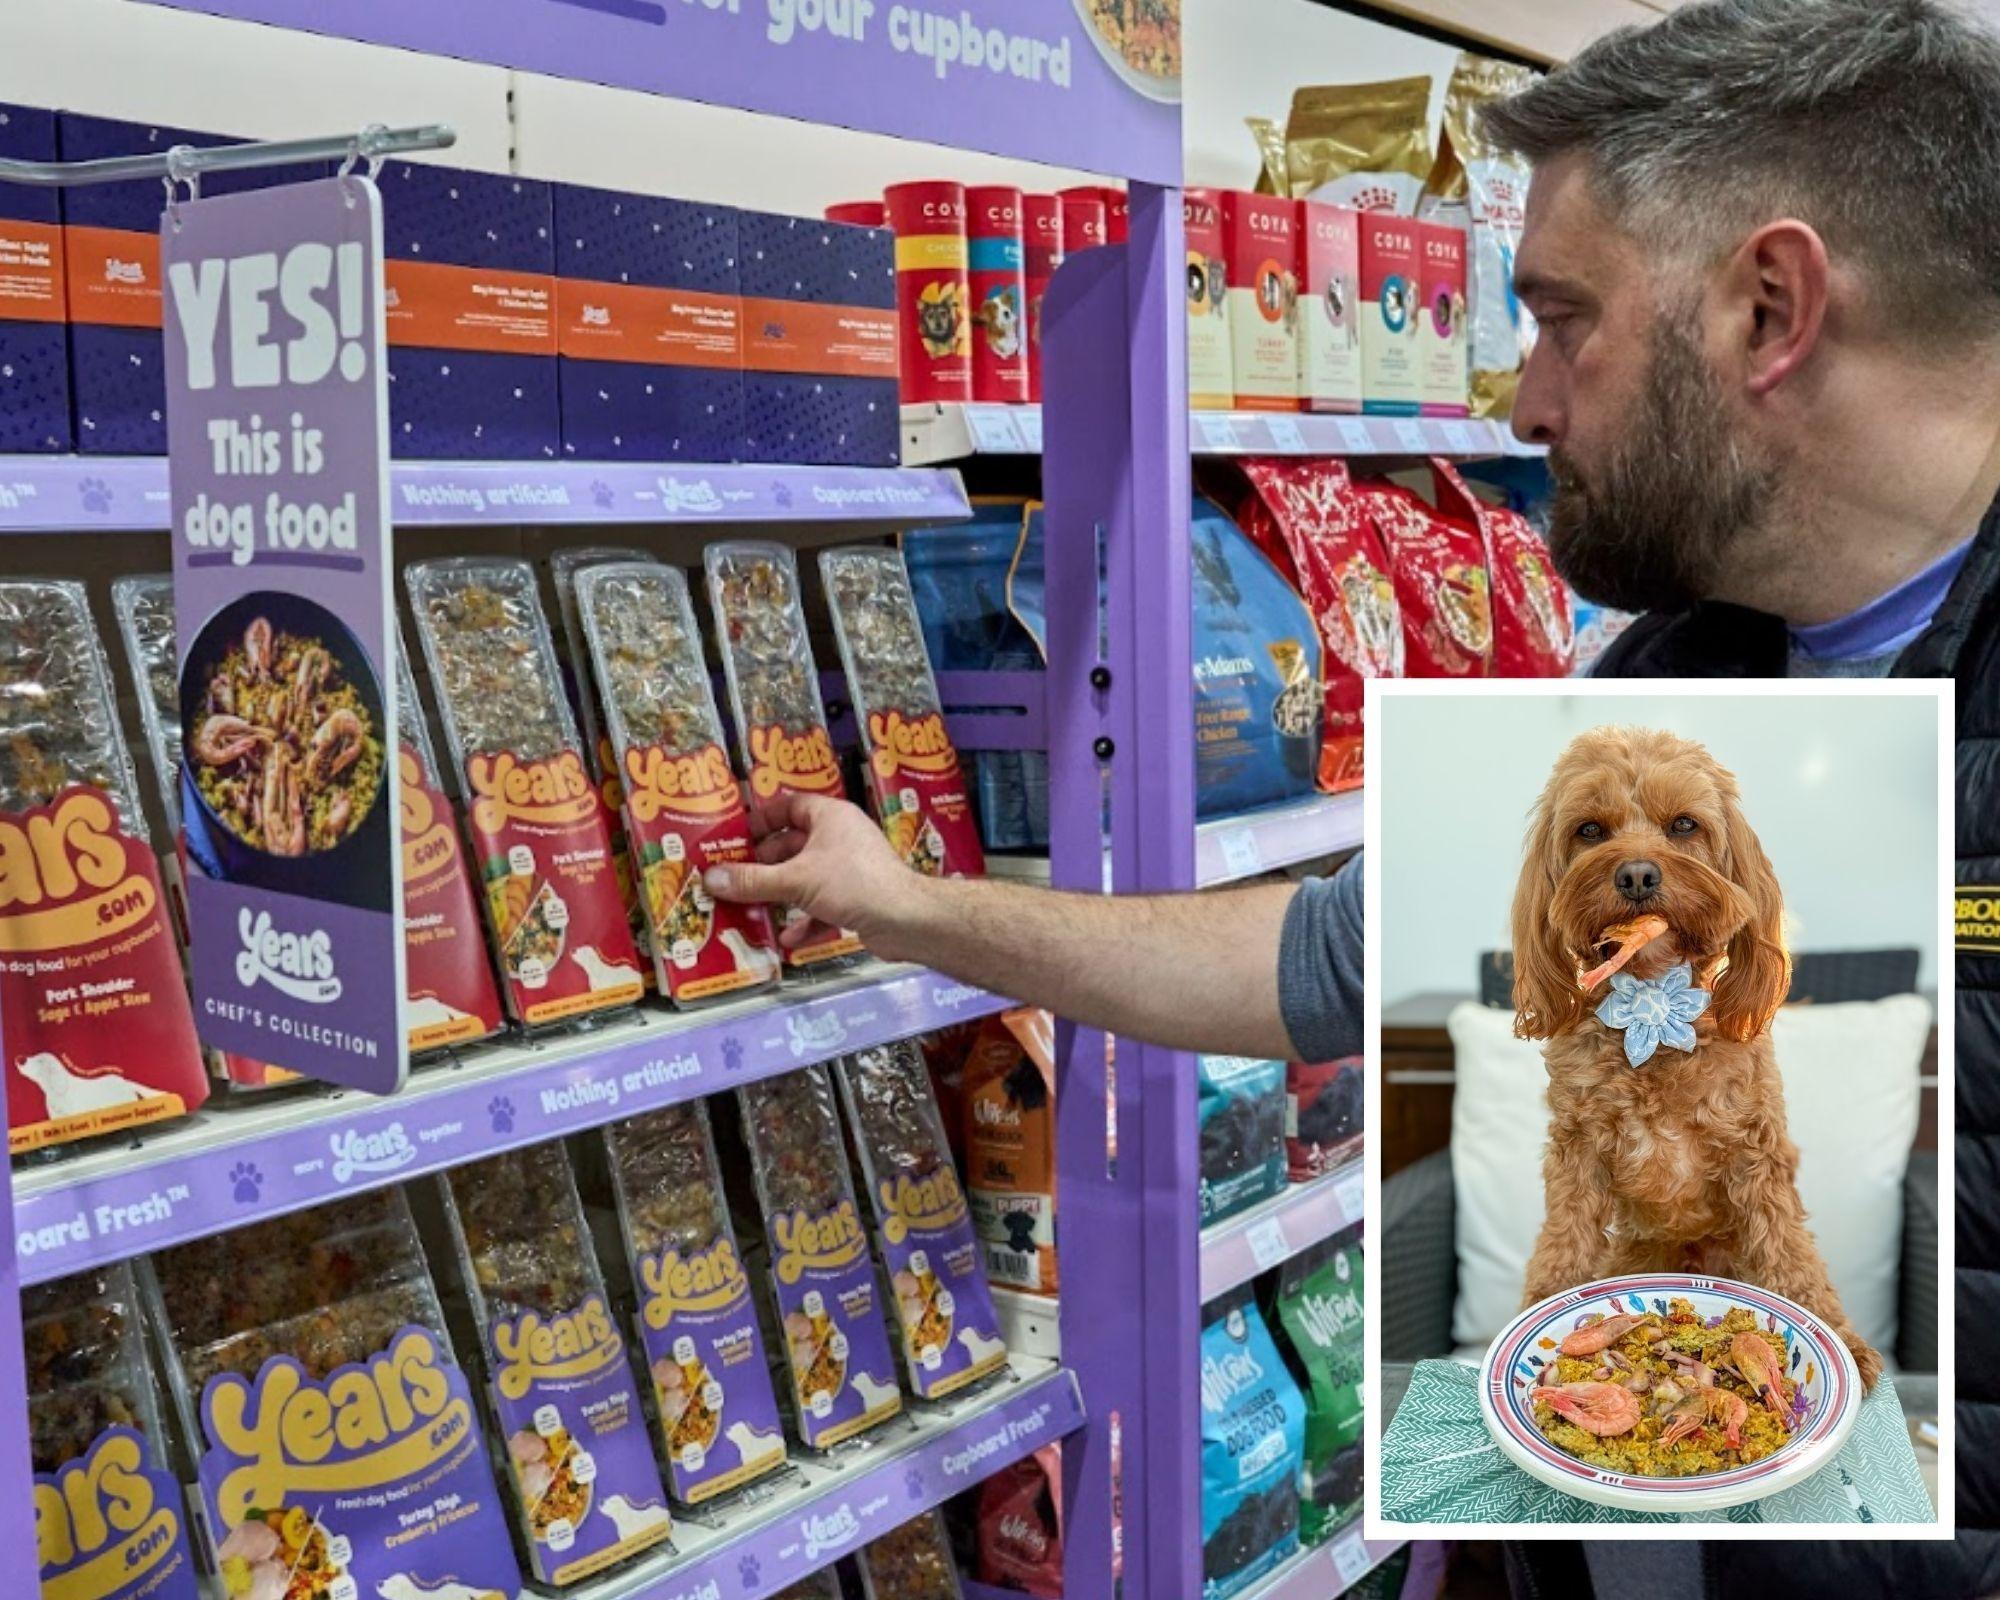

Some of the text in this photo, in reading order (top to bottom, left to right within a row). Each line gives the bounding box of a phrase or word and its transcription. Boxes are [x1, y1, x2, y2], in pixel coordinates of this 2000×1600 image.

[766, 0, 1070, 88] your cupboard
[1184, 204, 1215, 225] OYA
[1248, 211, 1289, 235] COYA
[1315, 221, 1350, 242] COYA
[1373, 231, 1413, 252] COYA
[1425, 240, 1460, 261] COYA
[168, 240, 367, 391] YES!
[207, 411, 325, 475] This is
[402, 483, 570, 512] Nothing artificial
[185, 491, 358, 567] dog food
[751, 726, 833, 798] Years
[869, 712, 949, 778] Years
[469, 752, 588, 835] Years
[627, 746, 730, 823] Years
[0, 794, 127, 908] ars
[96, 889, 146, 926] .com
[9, 960, 35, 977] dog
[36, 957, 65, 973] food
[65, 954, 83, 969] for
[84, 948, 110, 967] your
[236, 907, 336, 990] Years
[37, 1007, 71, 1024] Sage
[84, 997, 121, 1017] Apple
[122, 992, 151, 1006] Stew
[46, 976, 136, 1004] Pork Shoulder
[205, 998, 378, 1059] CHEF'S COLLECTION
[786, 1010, 843, 1056] Years
[134, 1103, 167, 1119] Support
[540, 1053, 702, 1115] Nothing artificial
[293, 1121, 464, 1183] more Years together
[18, 1211, 90, 1256] oard
[880, 1165, 959, 1244] Years
[998, 1199, 1039, 1213] PUPPY
[775, 1200, 859, 1285] Years
[643, 1239, 739, 1330] Years
[495, 1299, 612, 1400] Years
[211, 1333, 450, 1528] Years
[429, 1411, 468, 1451] .com
[942, 1432, 1010, 1476] Cupboard
[35, 1434, 155, 1570] ars
[398, 1493, 462, 1528] Turkey Thigh
[123, 1523, 170, 1571] .com
[801, 1503, 856, 1561] Years
